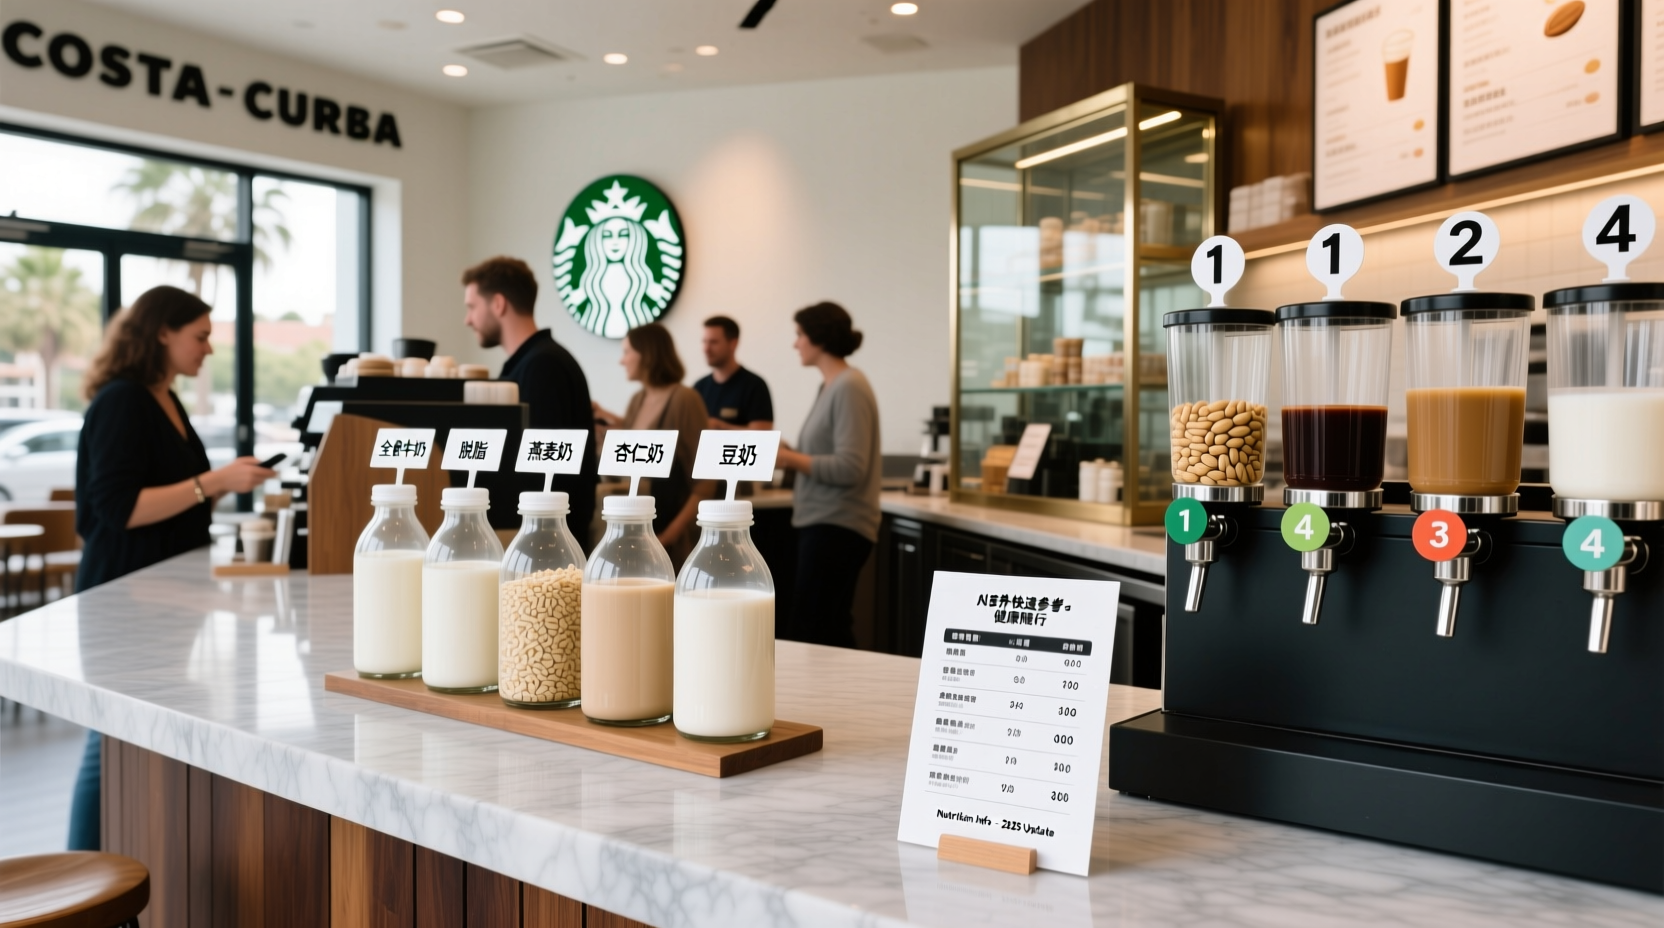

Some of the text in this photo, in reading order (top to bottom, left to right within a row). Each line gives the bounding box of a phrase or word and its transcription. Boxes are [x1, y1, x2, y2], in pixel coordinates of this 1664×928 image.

[1448, 219, 1483, 266] 2
[1595, 204, 1637, 253] 4
[1206, 244, 1223, 284] 1
[1322, 232, 1341, 275] 1
[458, 440, 489, 460] 脱脂
[527, 440, 573, 462] 燕麦奶
[614, 442, 665, 464] 杏仁奶
[718, 443, 758, 467] 豆奶
[1178, 508, 1191, 532] 1
[1293, 514, 1315, 541] 4
[1428, 520, 1450, 549] 3
[1579, 528, 1606, 559] 4
